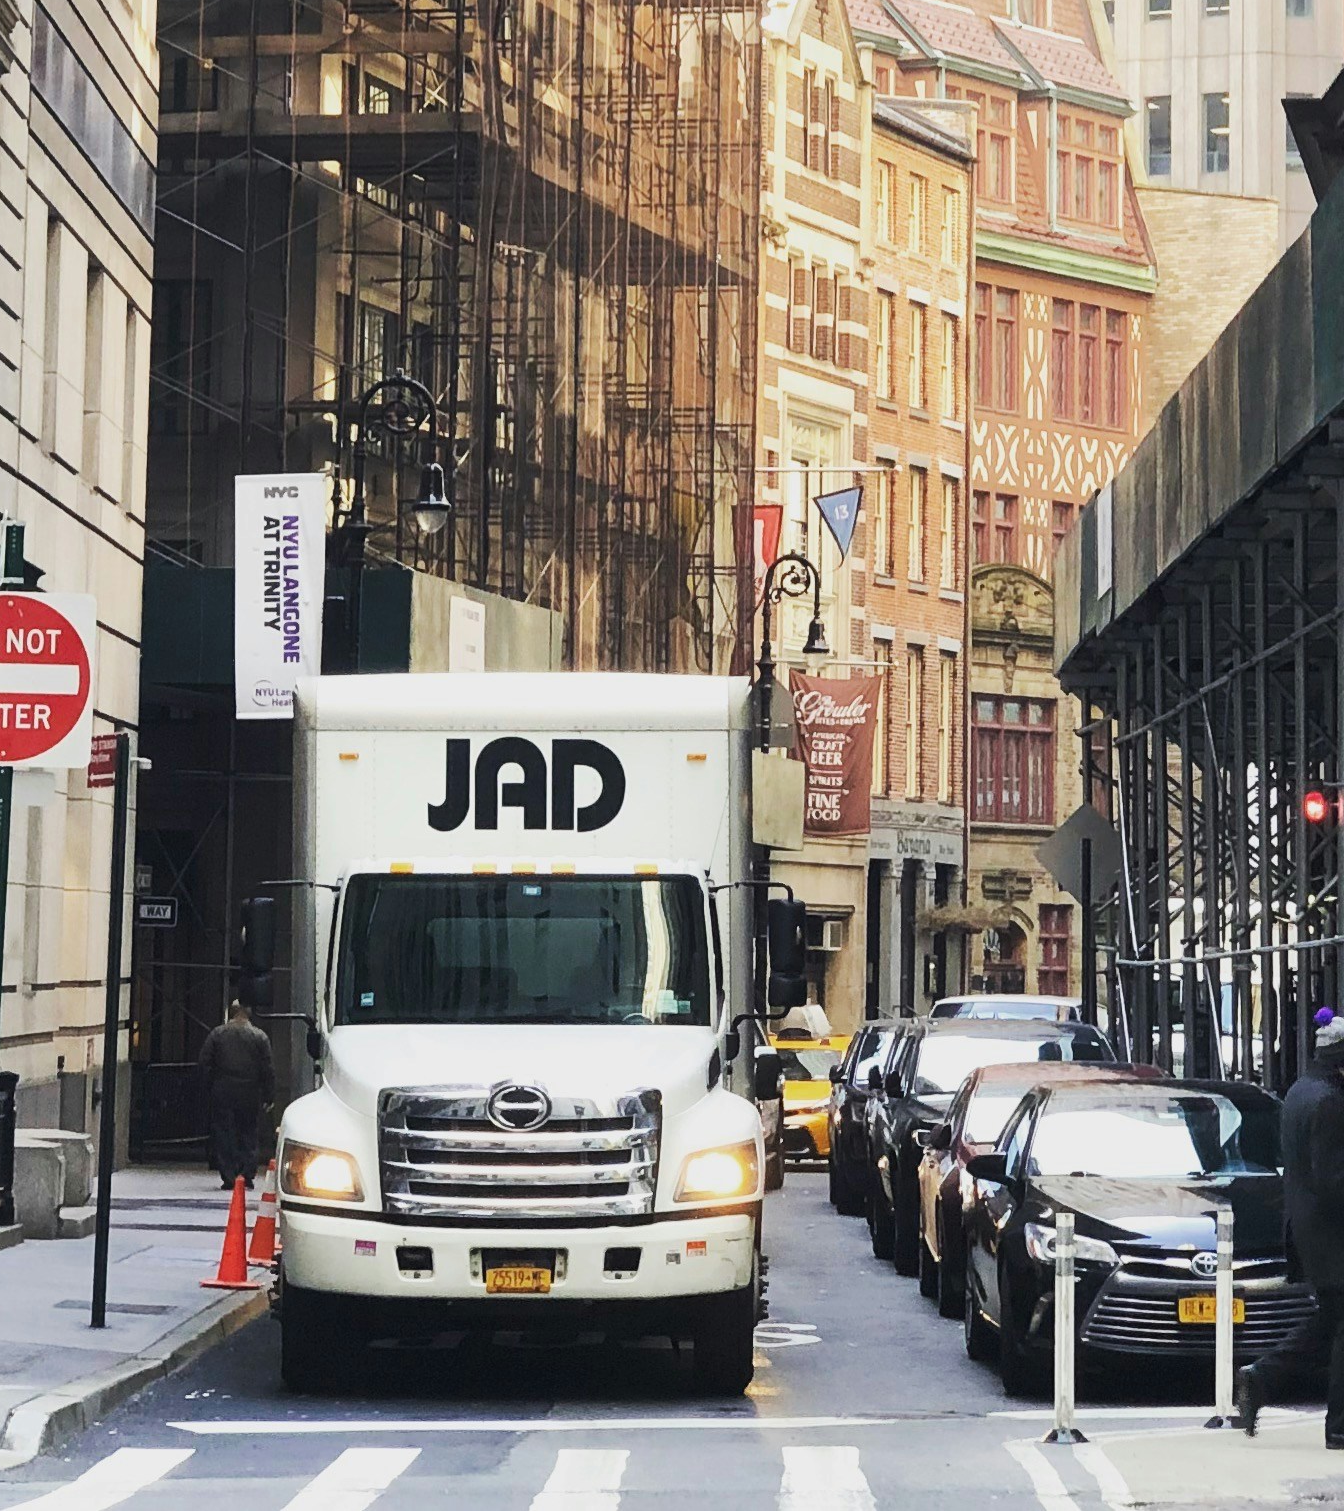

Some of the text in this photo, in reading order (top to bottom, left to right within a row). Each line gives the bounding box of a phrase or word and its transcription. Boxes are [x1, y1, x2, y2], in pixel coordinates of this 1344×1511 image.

[264, 486, 299, 499] NYC
[834, 504, 849, 520] 13
[263, 515, 281, 631] AT TRINITY
[282, 515, 300, 664] NYU LANGONE
[6, 628, 62, 655] NOT
[255, 688, 275, 697] NYU
[811, 740, 846, 751] CRAFT
[810, 751, 843, 766] BEER
[427, 736, 626, 833] JAD
[807, 792, 842, 809] FINE
[146, 906, 169, 917] WAY
